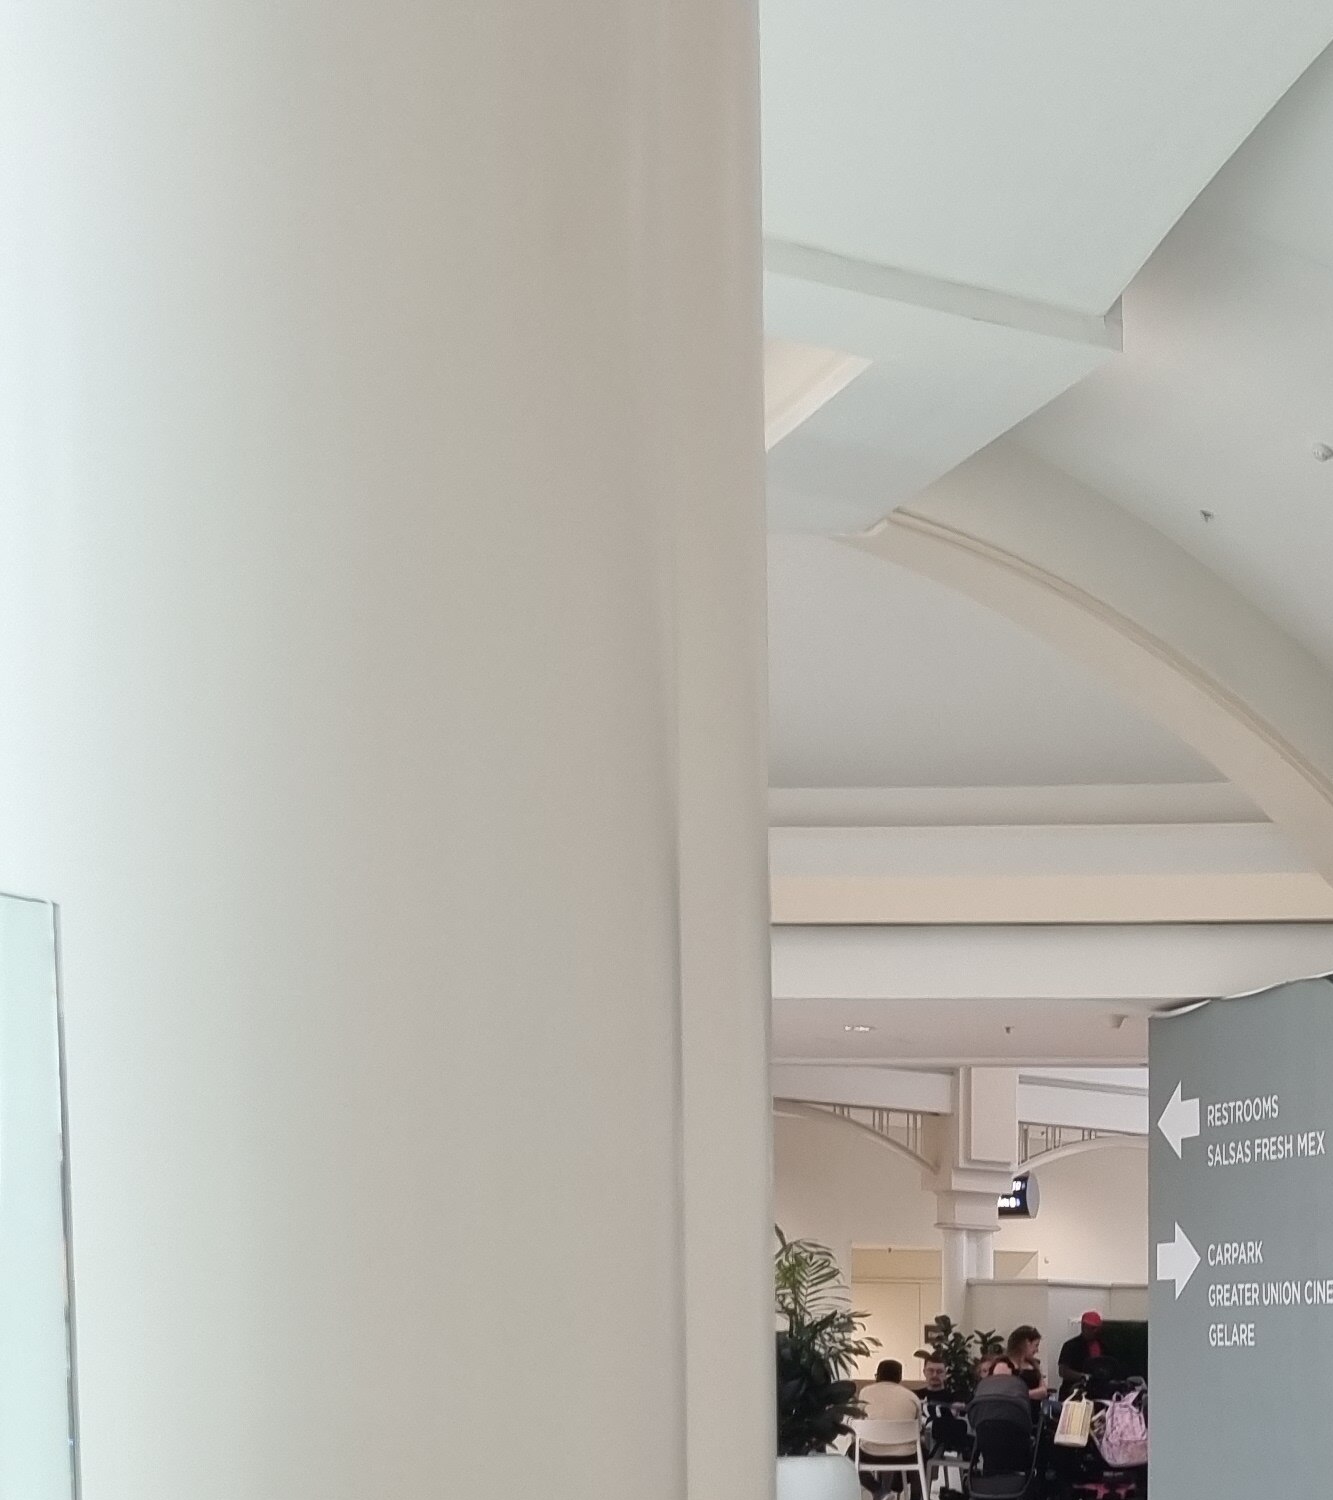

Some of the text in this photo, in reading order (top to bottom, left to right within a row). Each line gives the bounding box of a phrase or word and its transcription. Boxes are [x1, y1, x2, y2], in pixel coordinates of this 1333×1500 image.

[1207, 1094, 1279, 1127] RESTROOMS
[1207, 1130, 1326, 1167] SALSAS FRESH MEX
[1207, 1240, 1264, 1266] CARPARK
[1208, 1282, 1260, 1307] GREATER
[1262, 1280, 1301, 1306] UNION
[1208, 1322, 1256, 1347] GELARE
